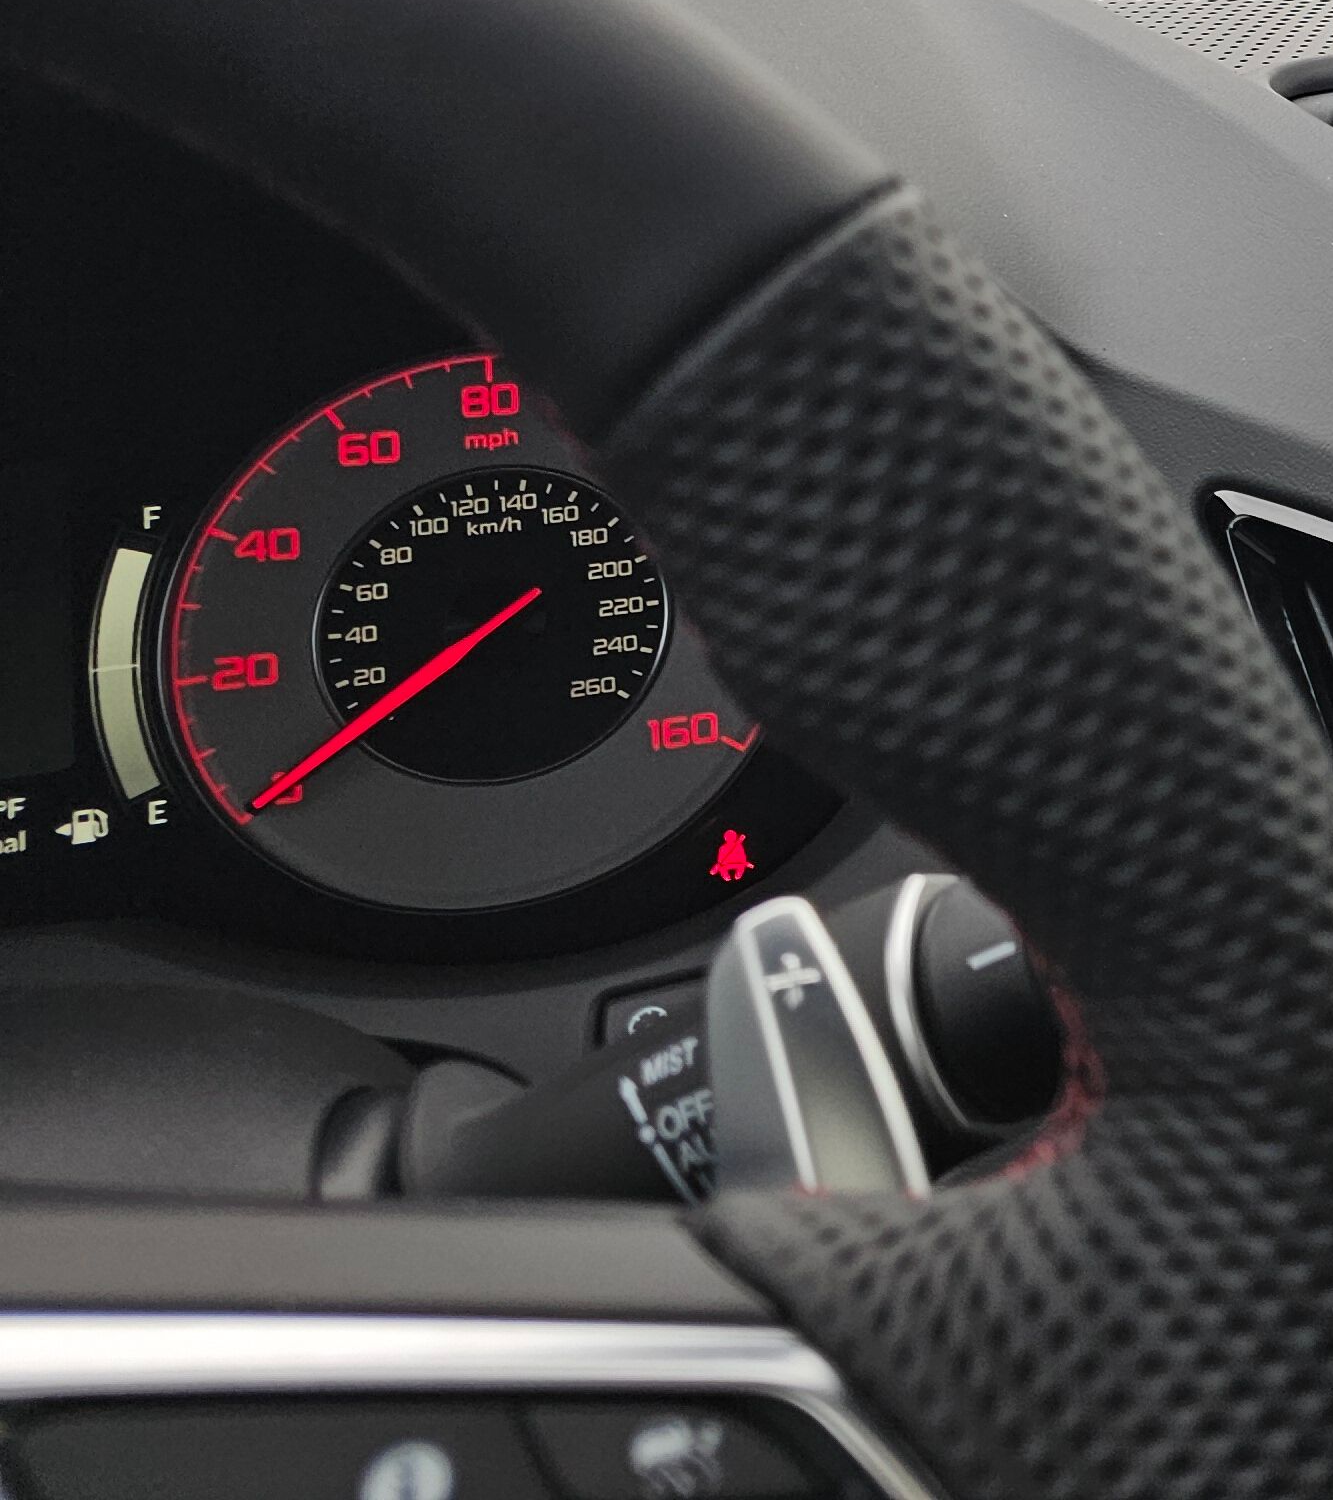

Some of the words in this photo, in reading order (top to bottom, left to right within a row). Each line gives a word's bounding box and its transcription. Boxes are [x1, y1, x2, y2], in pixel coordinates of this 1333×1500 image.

[461, 383, 520, 419] 80
[336, 430, 401, 468] 60
[464, 428, 519, 452] mph
[451, 497, 489, 518] 120
[499, 493, 537, 513] 140
[142, 505, 162, 530] F
[541, 505, 580, 525] 160
[409, 517, 449, 537] 100
[466, 517, 522, 537] km/h
[569, 527, 609, 548] 180
[232, 527, 301, 563] 40
[379, 546, 413, 566] 80
[587, 559, 633, 581] 200
[355, 582, 389, 602] 60
[598, 596, 644, 618] 220
[344, 624, 378, 644] 40
[592, 634, 638, 656] 240
[211, 653, 280, 692] 20
[352, 666, 386, 687] 20
[569, 676, 617, 699] 260
[646, 711, 720, 751] 160
[147, 799, 168, 826] E
[639, 1035, 699, 1087] MIST
[656, 1087, 714, 1141] OFF
